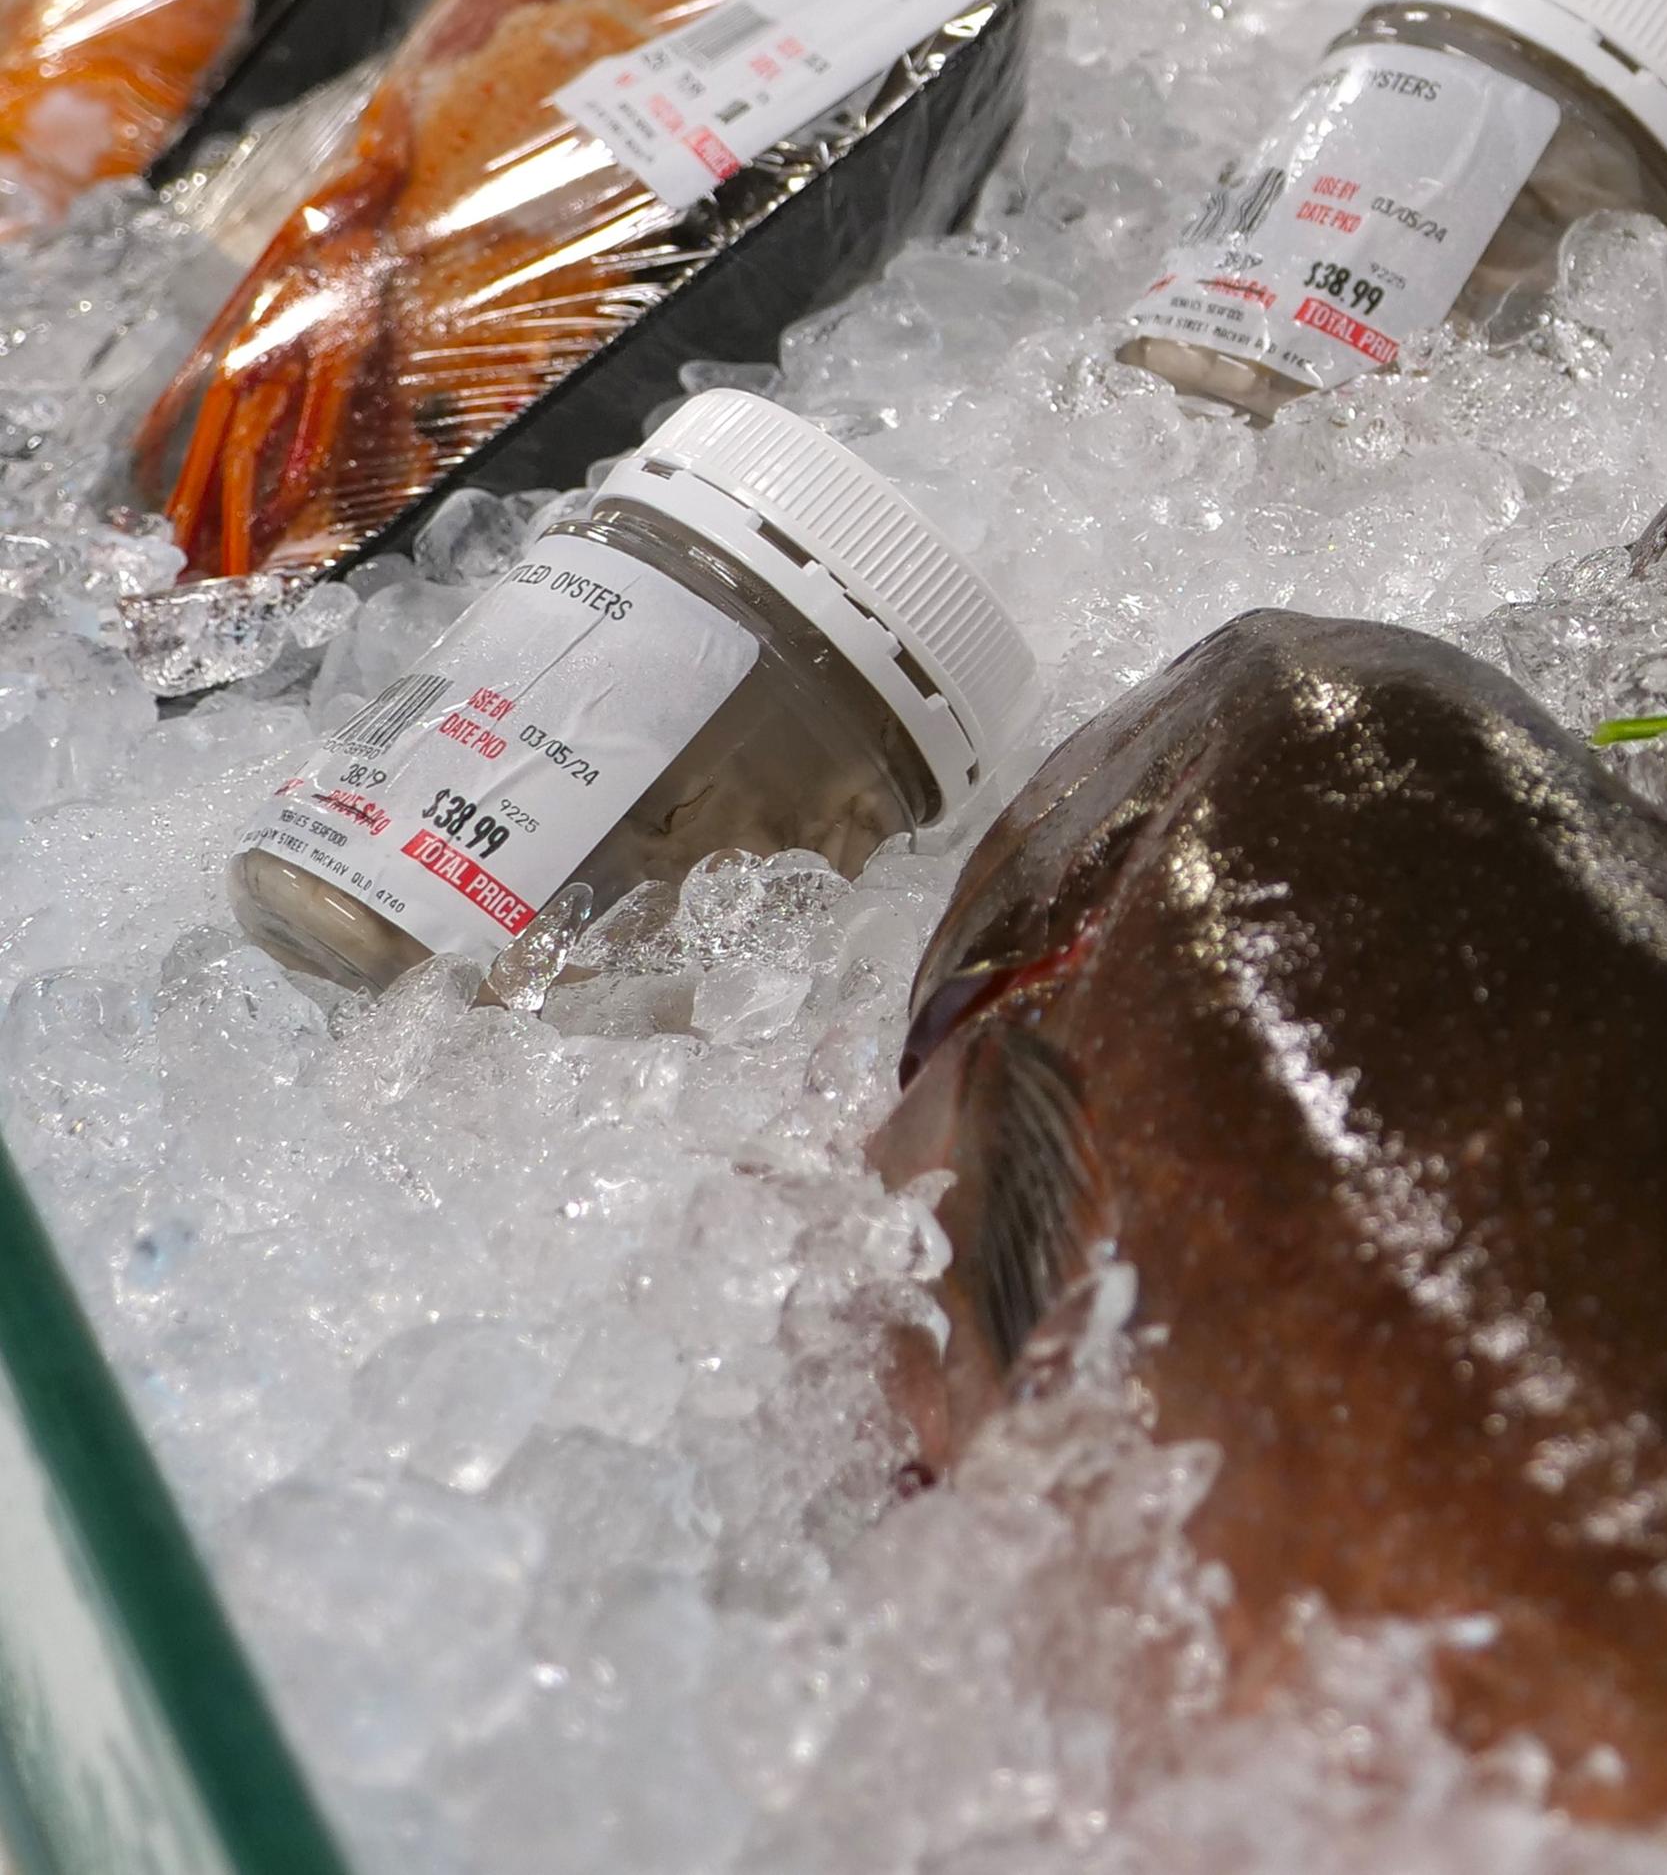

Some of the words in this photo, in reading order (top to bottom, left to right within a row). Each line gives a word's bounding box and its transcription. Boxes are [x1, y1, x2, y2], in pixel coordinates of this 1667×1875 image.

[1306, 301, 1356, 343] TOTAL
[551, 571, 633, 621] OYSTERS
[488, 698, 516, 722] BY
[439, 712, 481, 745] DATE
[470, 730, 508, 759] PKD
[519, 724, 601, 787] 03/05/24
[422, 788, 511, 860] $38.99
[500, 798, 541, 834] 9225
[310, 848, 350, 877] MACKAY
[351, 871, 374, 892] QLD
[376, 889, 407, 914] 4740
[412, 836, 471, 886] TOTAL
[465, 873, 527, 928] PRICE
